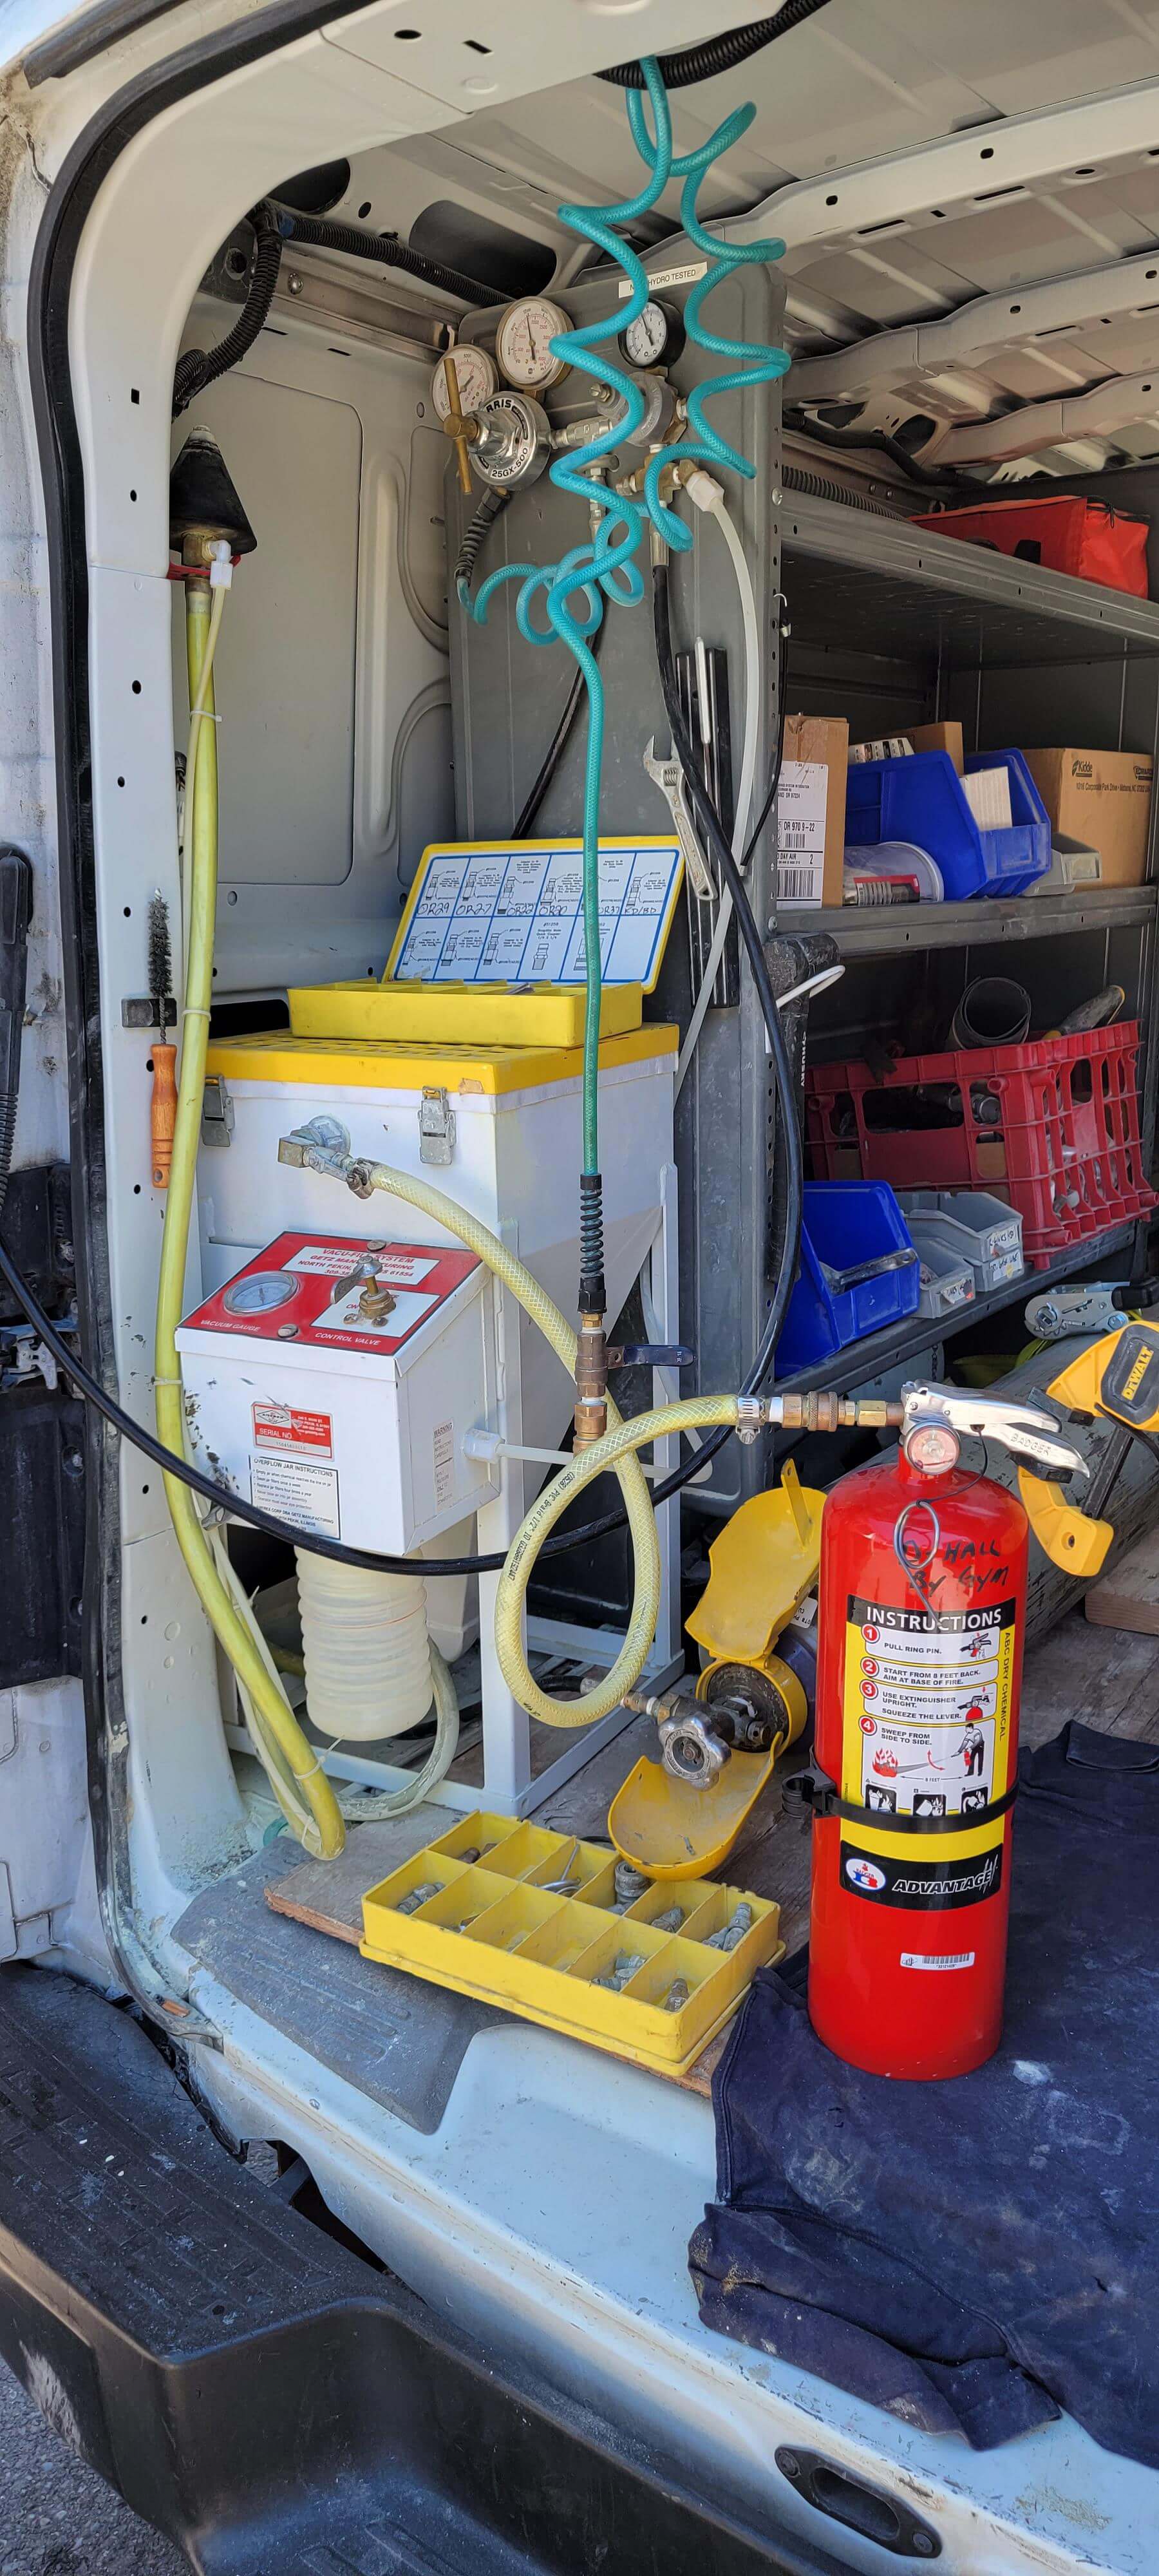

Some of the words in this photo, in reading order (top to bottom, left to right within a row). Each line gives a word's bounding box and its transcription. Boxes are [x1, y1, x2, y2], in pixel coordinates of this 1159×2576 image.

[671, 269, 696, 280] TESTED
[486, 399, 512, 413] RRIS
[491, 447, 528, 478] 25GX-500
[1079, 761, 1093, 773] Kidde
[784, 821, 791, 831] OR
[792, 822, 801, 831] 970
[802, 822, 815, 832] 9-22
[809, 854, 813, 864] 2
[417, 902, 450, 916] OR29
[456, 903, 492, 915] OR27
[337, 1258, 415, 1270] MANTURING
[201, 1320, 232, 1329] VACUUM
[232, 1323, 260, 1332] GAUGE
[314, 1332, 353, 1342] CONTROL
[1124, 1345, 1154, 1399] DEWALT
[259, 1428, 281, 1437] SERIAL
[434, 1422, 453, 1439] WARNING
[1010, 1433, 1051, 1456] BADGER
[254, 1458, 282, 1468] OVERFLOW
[294, 1464, 333, 1477] INSTRUCTIONS
[549, 1490, 560, 1502] PVC
[537, 1499, 552, 1519] Braid
[302, 1514, 334, 1524] MANUFACTURING
[943, 1539, 1000, 1564] HALL
[867, 1607, 1001, 1631] INSTRUCTIONS
[867, 1629, 873, 1639] 1
[884, 1642, 903, 1651] PULL
[865, 1662, 873, 1672] 2
[883, 1667, 907, 1676] START
[865, 1684, 872, 1694] 3
[899, 1695, 956, 1703] EXTINGUISHER
[883, 1698, 918, 1708] UPRIGHT.
[882, 1708, 917, 1719] SQUEEZE
[999, 1683, 1008, 1741] CHEMICAL
[863, 1720, 871, 1729] 4
[881, 1727, 907, 1736] SWEEP
[881, 1733, 899, 1742] SIDE
[892, 1870, 992, 1895] ADVANTAGE
